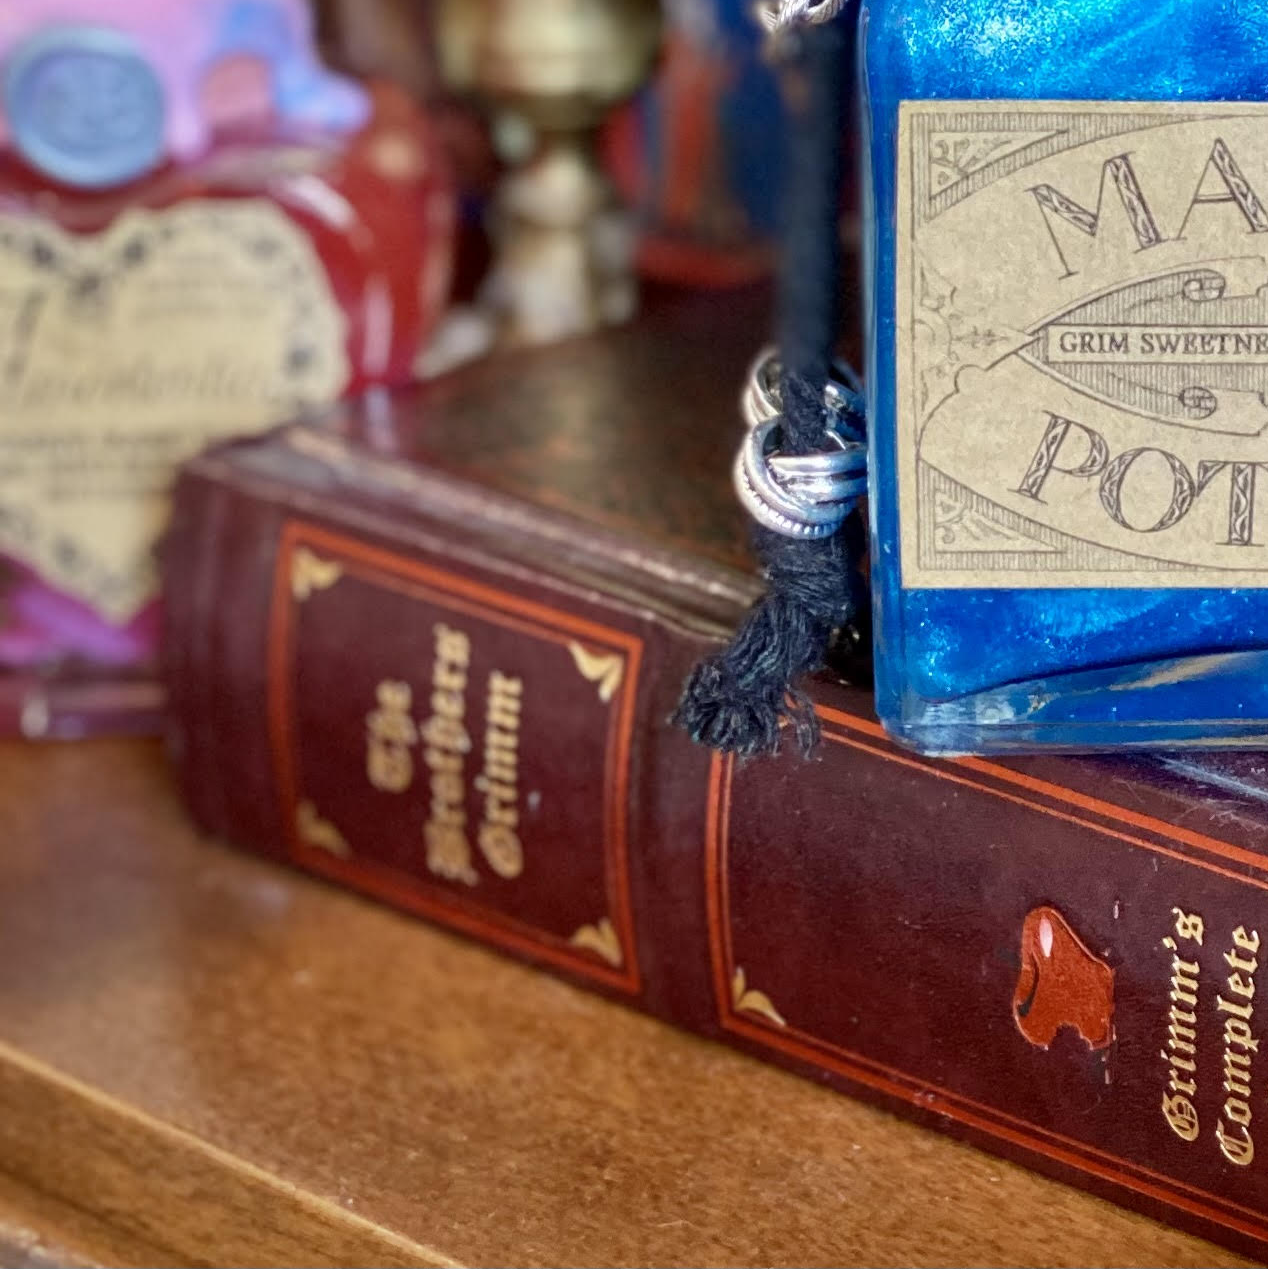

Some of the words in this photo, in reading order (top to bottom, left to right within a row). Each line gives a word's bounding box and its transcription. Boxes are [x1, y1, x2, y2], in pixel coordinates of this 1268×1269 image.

[1058, 331, 1130, 355] GRIM
[474, 670, 525, 879] Grimm
[1161, 907, 1205, 1142] Grimm's
[1215, 925, 1261, 1166] Complete
